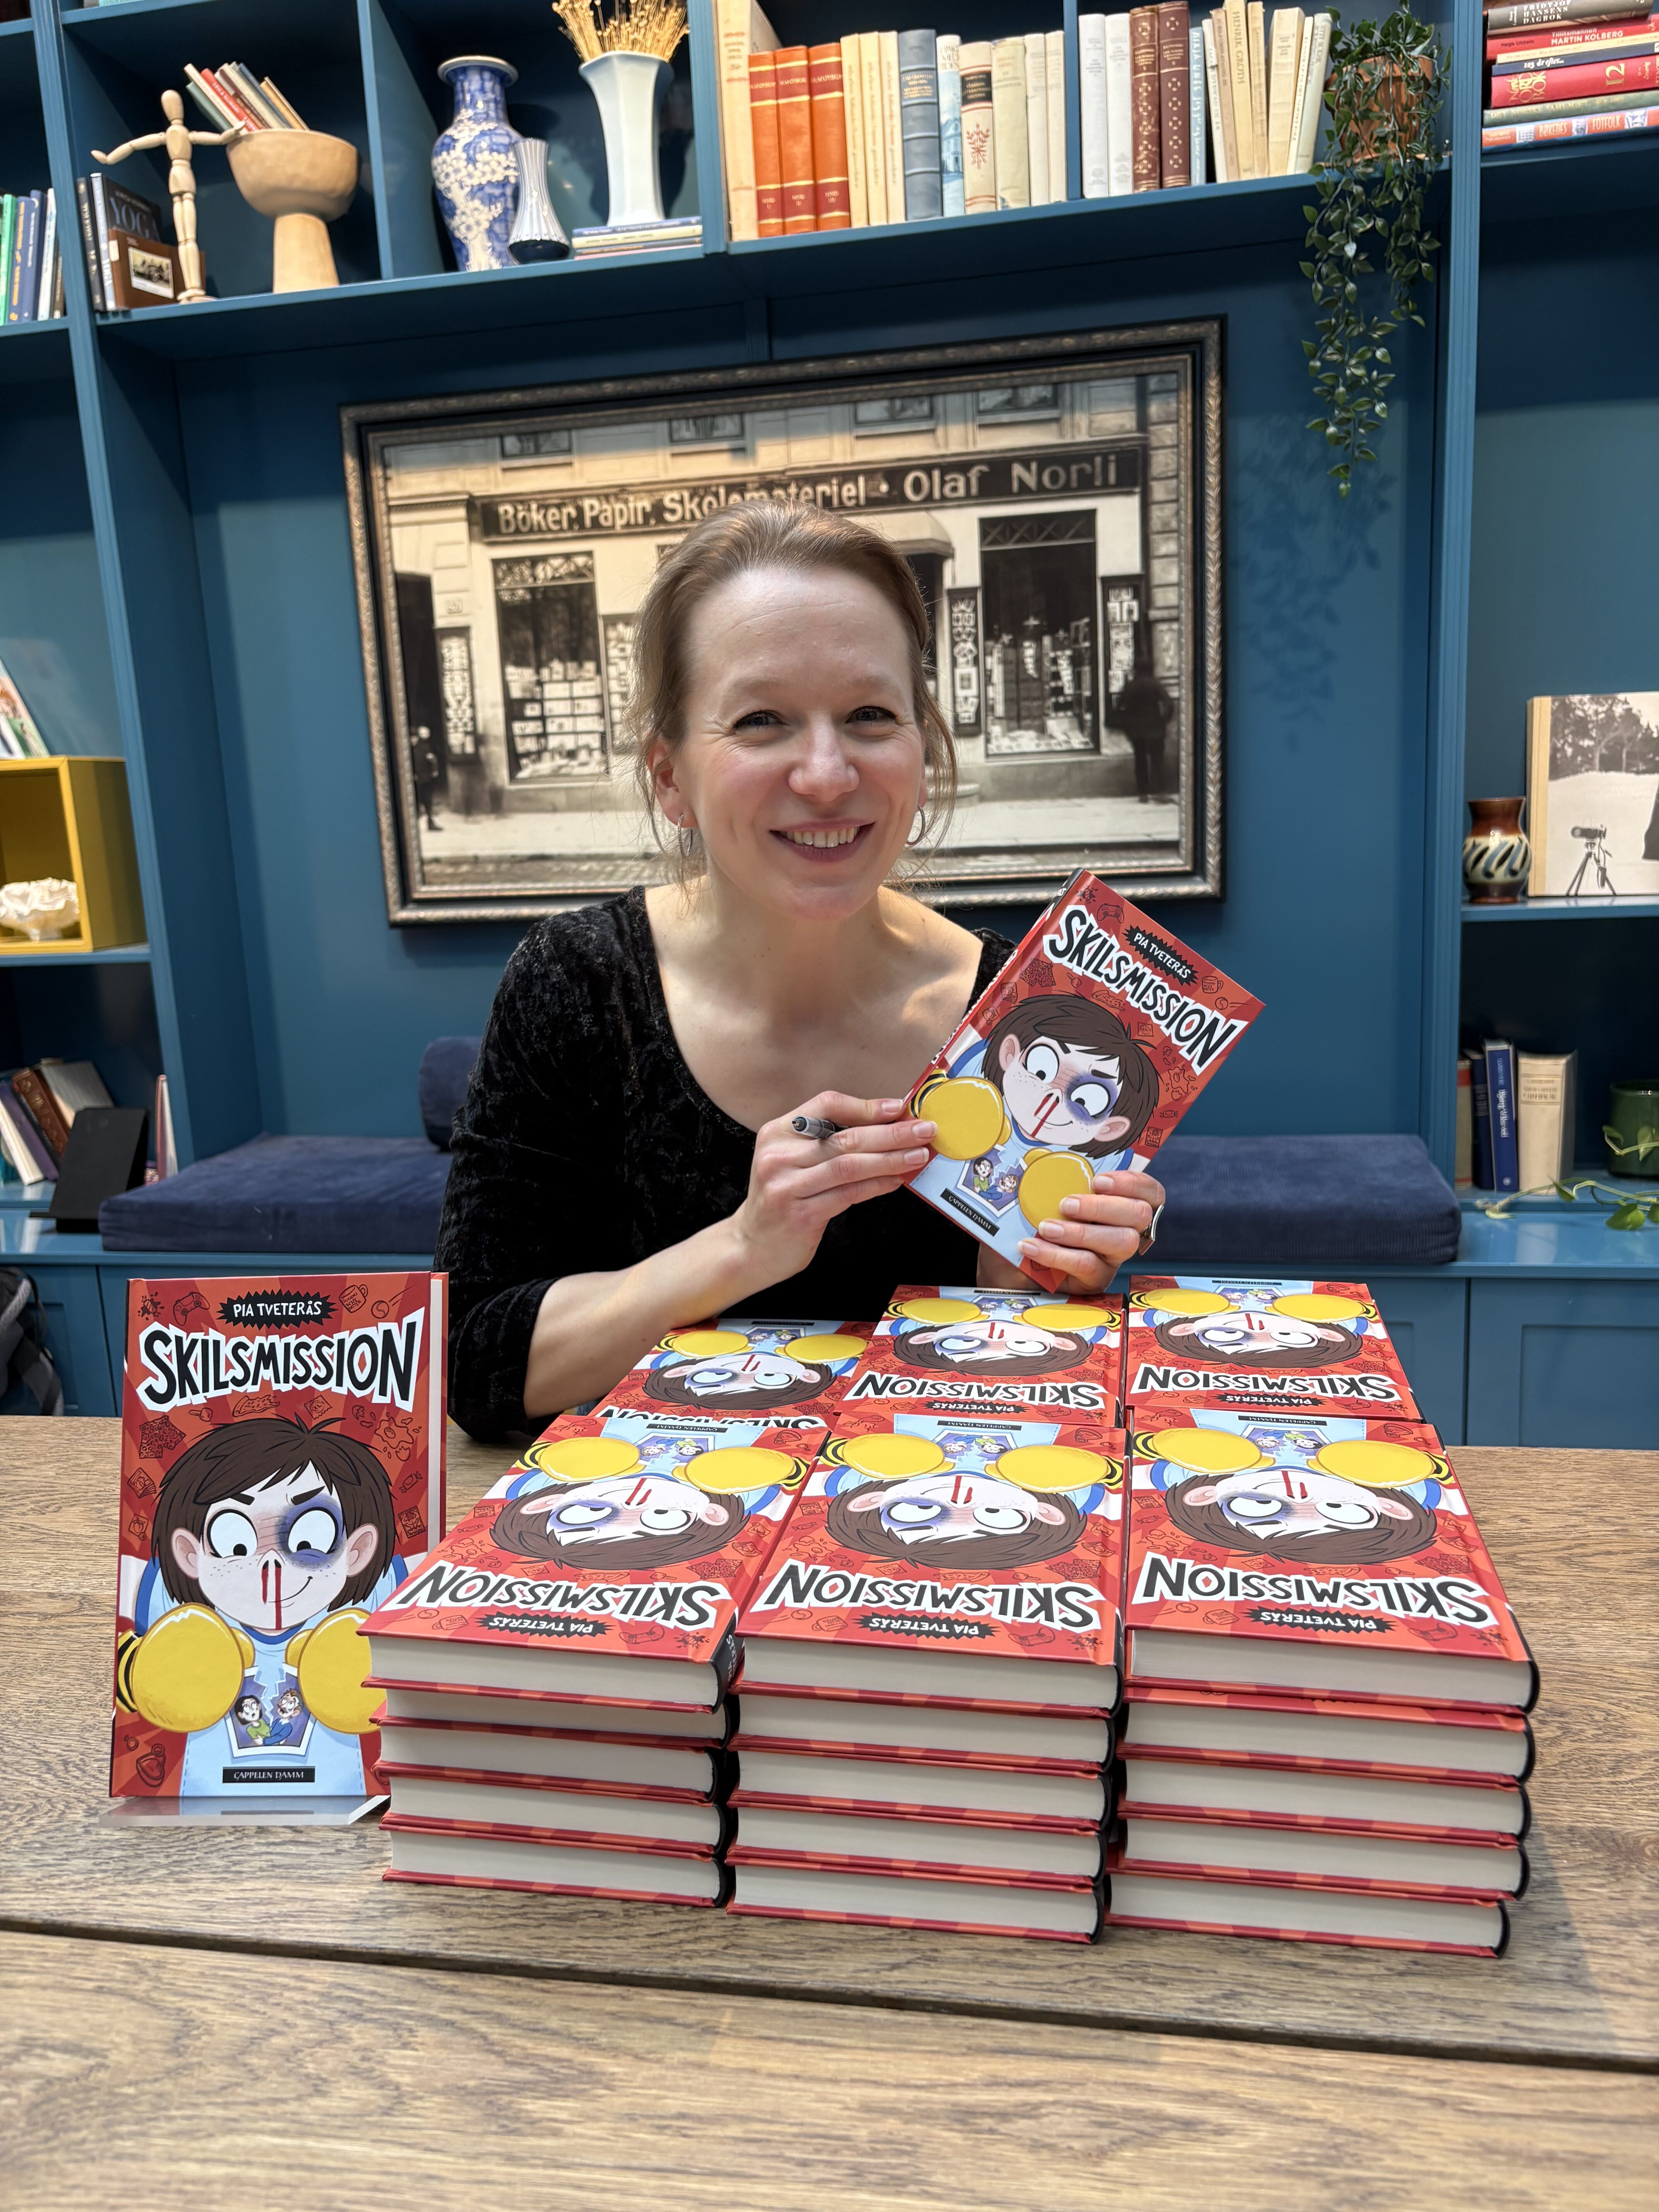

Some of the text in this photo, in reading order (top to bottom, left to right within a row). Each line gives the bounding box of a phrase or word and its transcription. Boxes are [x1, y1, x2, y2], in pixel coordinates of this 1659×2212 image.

[1551, 30, 1623, 46] MARTIN KOLBERG
[1519, 72, 1532, 103] ORD
[1532, 71, 1546, 101] BOK
[1605, 63, 1625, 85] 12
[1592, 115, 1621, 131] FOTFOLK
[903, 466, 991, 502] Olaf
[1012, 454, 1117, 493] Norli
[1133, 932, 1191, 979] PIA TVETERÅS
[1049, 909, 1238, 1068] SKILSMISSION
[949, 1195, 991, 1230] CAPPELEN DAMM
[233, 1300, 322, 1317] PIA TVETERÅS
[144, 1321, 417, 1405] SKILSMISSION
[853, 1374, 1099, 1407] SKILSMISSION
[1138, 1367, 1395, 1399] SKILSMISSION
[932, 1403, 993, 1411] TVETERÅS
[1226, 1395, 1289, 1403] TVETERÅS
[399, 1565, 719, 1626] SKILSMISSION
[764, 1565, 1094, 1628] SKILSMISSION
[1143, 1558, 1488, 1623] SKILSMISSION
[489, 1617, 593, 1633] PIA TVETERÅS
[869, 1618, 979, 1635] PIA TVETERÅS
[1260, 1611, 1377, 1629] PIA TVETERÅS
[233, 1771, 304, 1781] CAPPELEN DAMM
